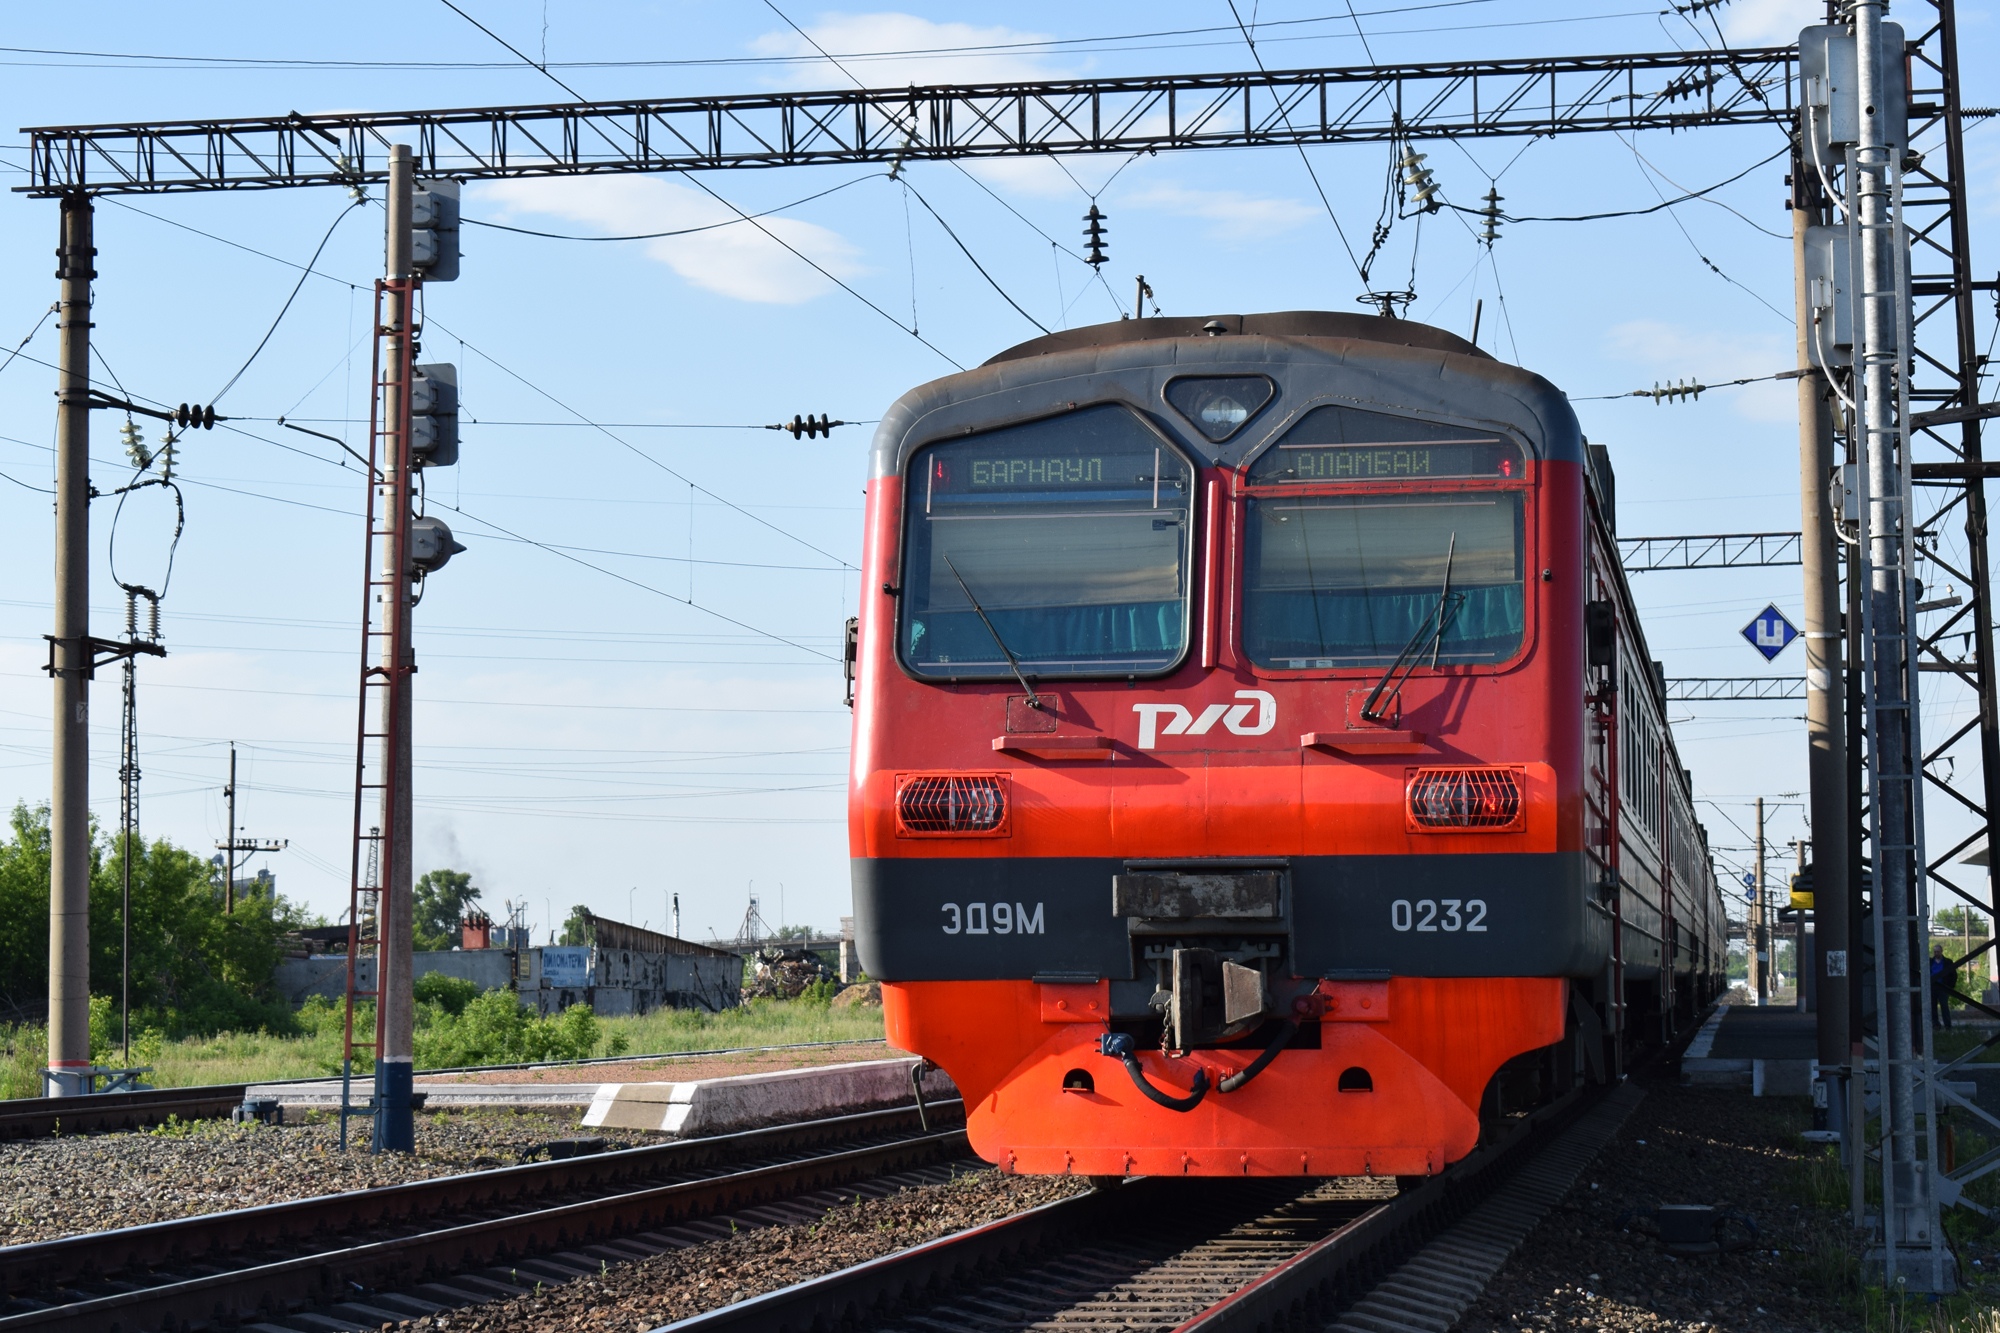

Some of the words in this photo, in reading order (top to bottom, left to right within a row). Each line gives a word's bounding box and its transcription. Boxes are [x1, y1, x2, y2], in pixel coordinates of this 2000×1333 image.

[973, 458, 1103, 484] БАРНАУЛ
[941, 902, 1045, 934] ЭД9М
[1391, 899, 1488, 932] 0232
